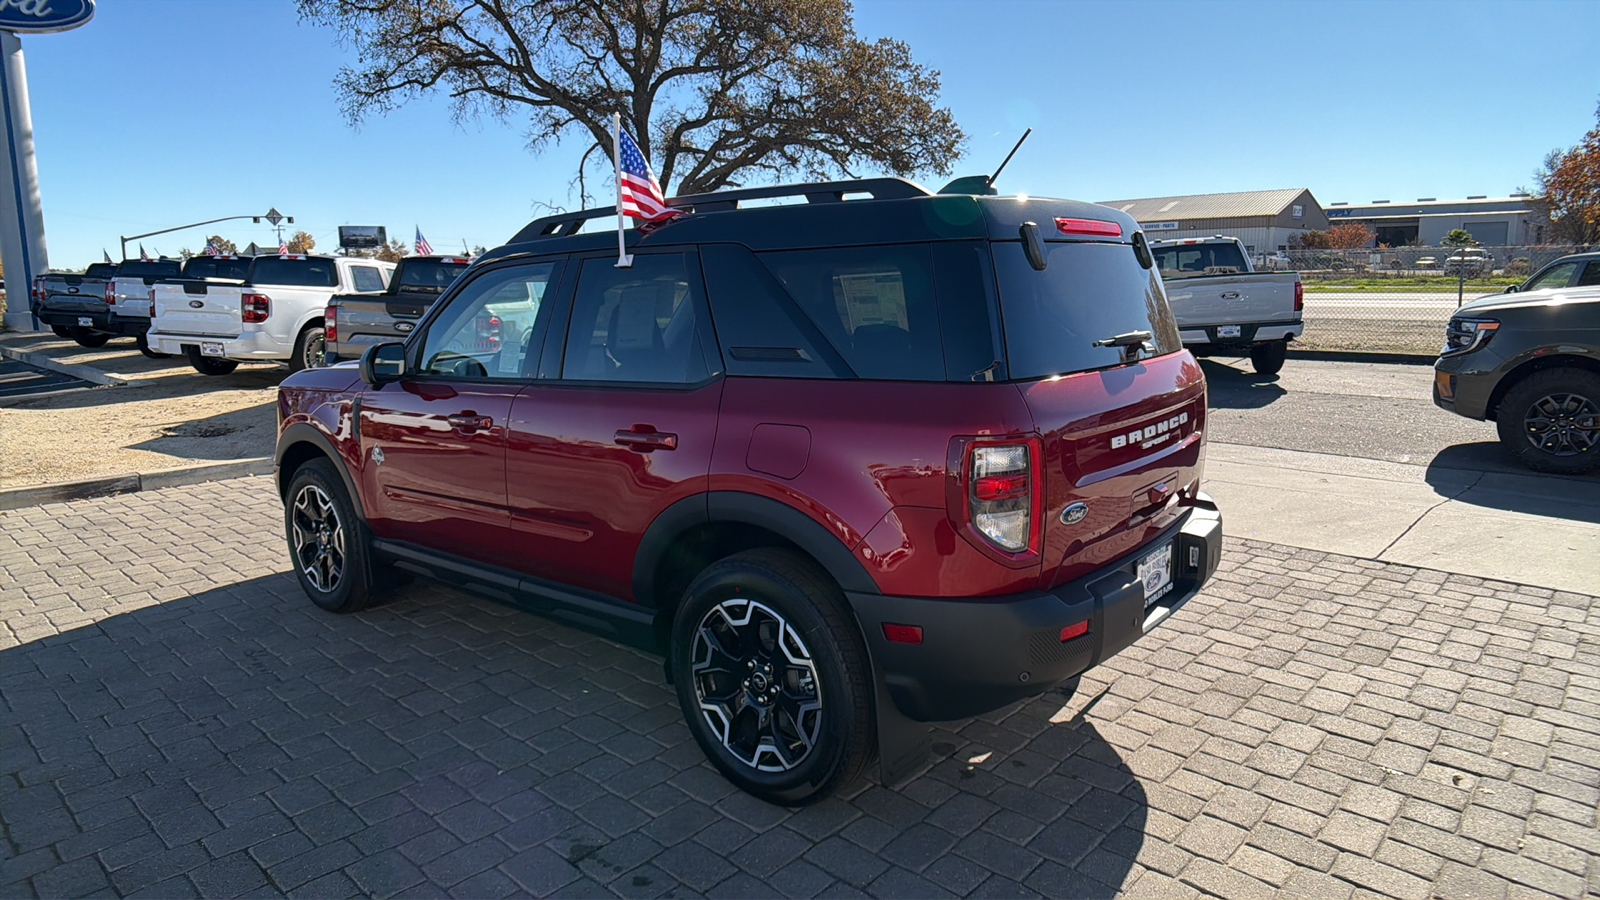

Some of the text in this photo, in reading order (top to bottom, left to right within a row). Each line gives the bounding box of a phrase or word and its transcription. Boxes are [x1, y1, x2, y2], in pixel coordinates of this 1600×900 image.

[1111, 412, 1188, 449] BRONCO
[1142, 432, 1170, 449] SPORT
[1063, 504, 1087, 522] Ford
